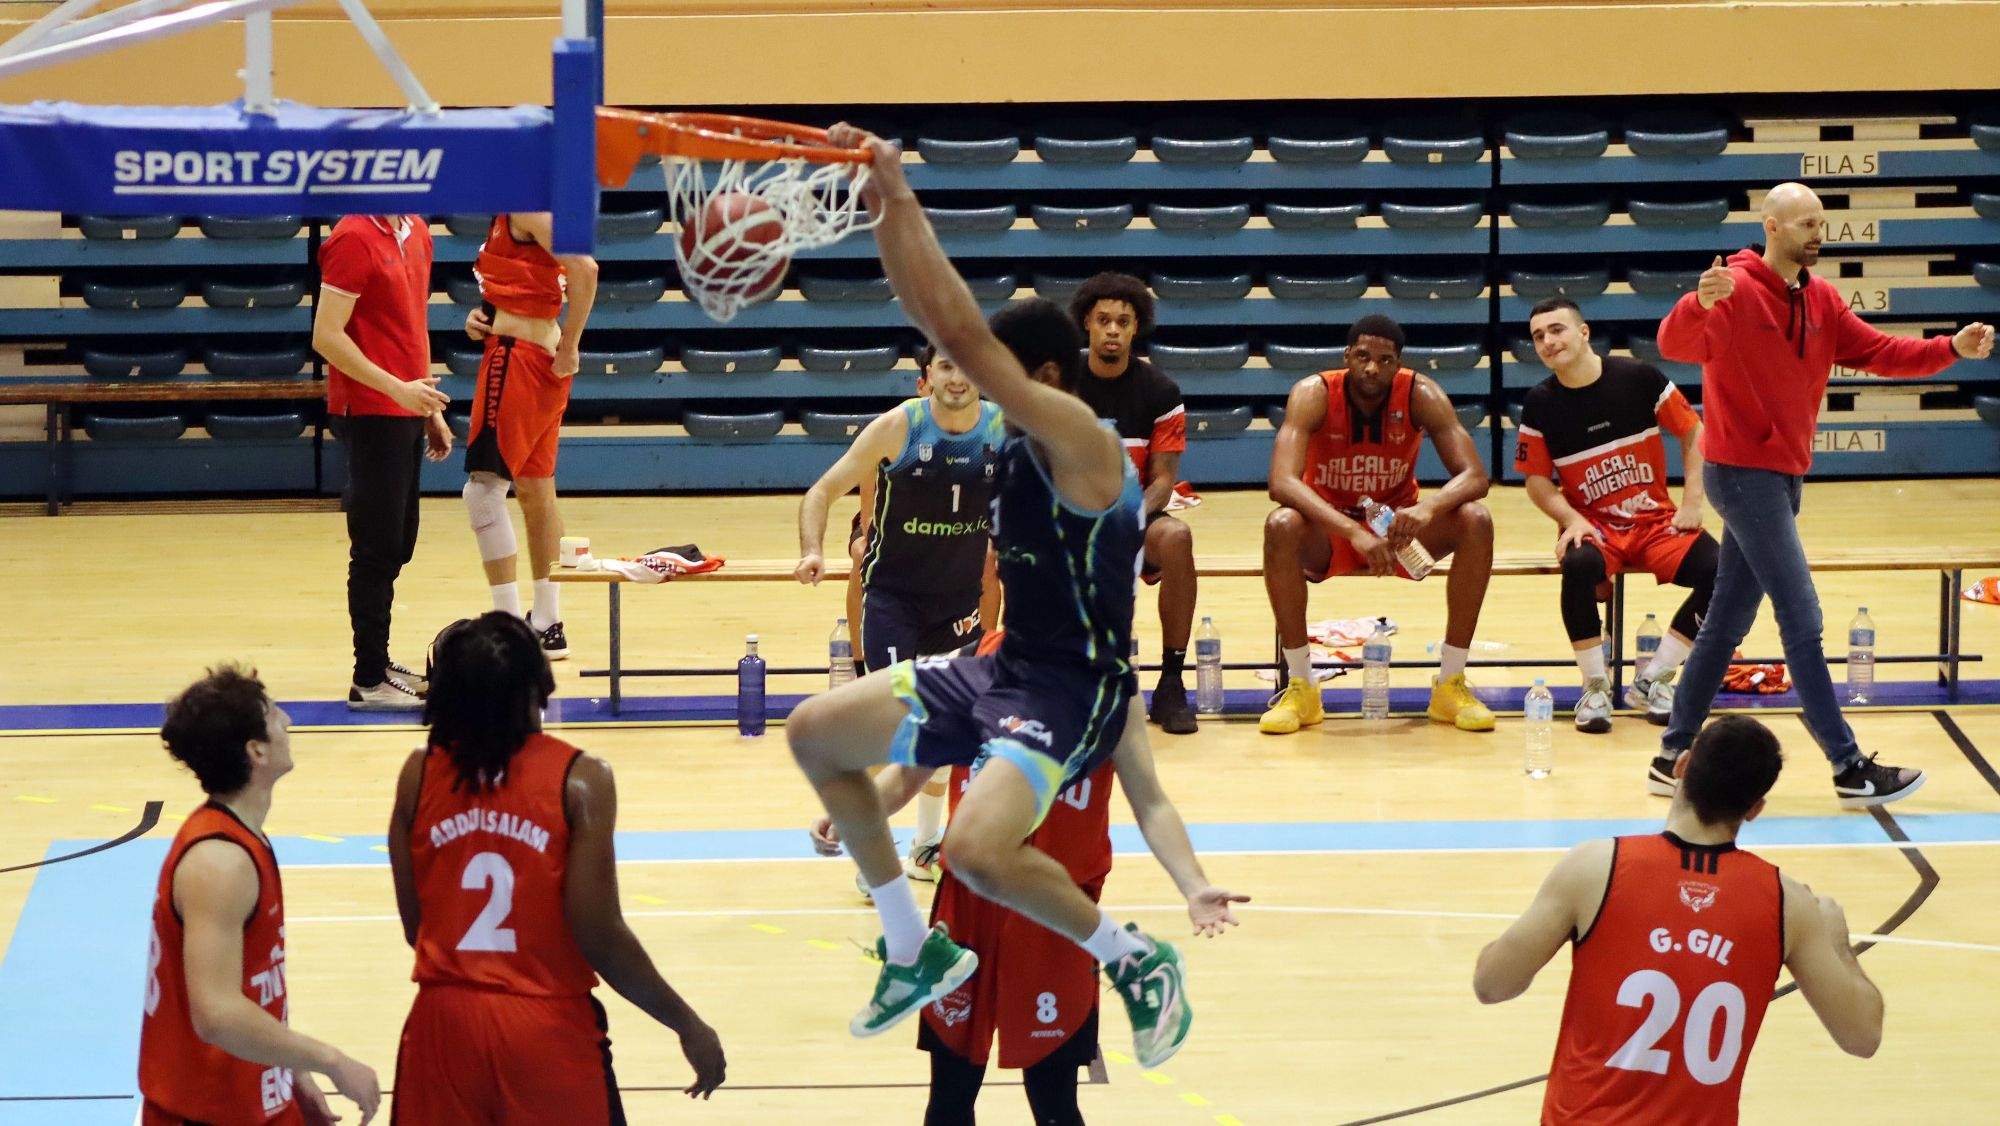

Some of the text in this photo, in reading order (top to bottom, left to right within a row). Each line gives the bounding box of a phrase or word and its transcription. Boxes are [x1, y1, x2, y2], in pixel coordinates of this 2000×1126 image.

[1803, 154, 1875, 174] FILA 5
[1825, 222, 1875, 242] LA 4
[1874, 290, 1887, 310] 3
[487, 346, 506, 427] JUVENTUD
[1812, 431, 1882, 451] FILA 1
[1328, 455, 1402, 475] ALCALA
[1585, 454, 1637, 484] ALCALA
[951, 484, 961, 513] 1
[455, 851, 518, 952] 2
[1036, 991, 1058, 1024] 8
[1604, 969, 1746, 1086] 20
